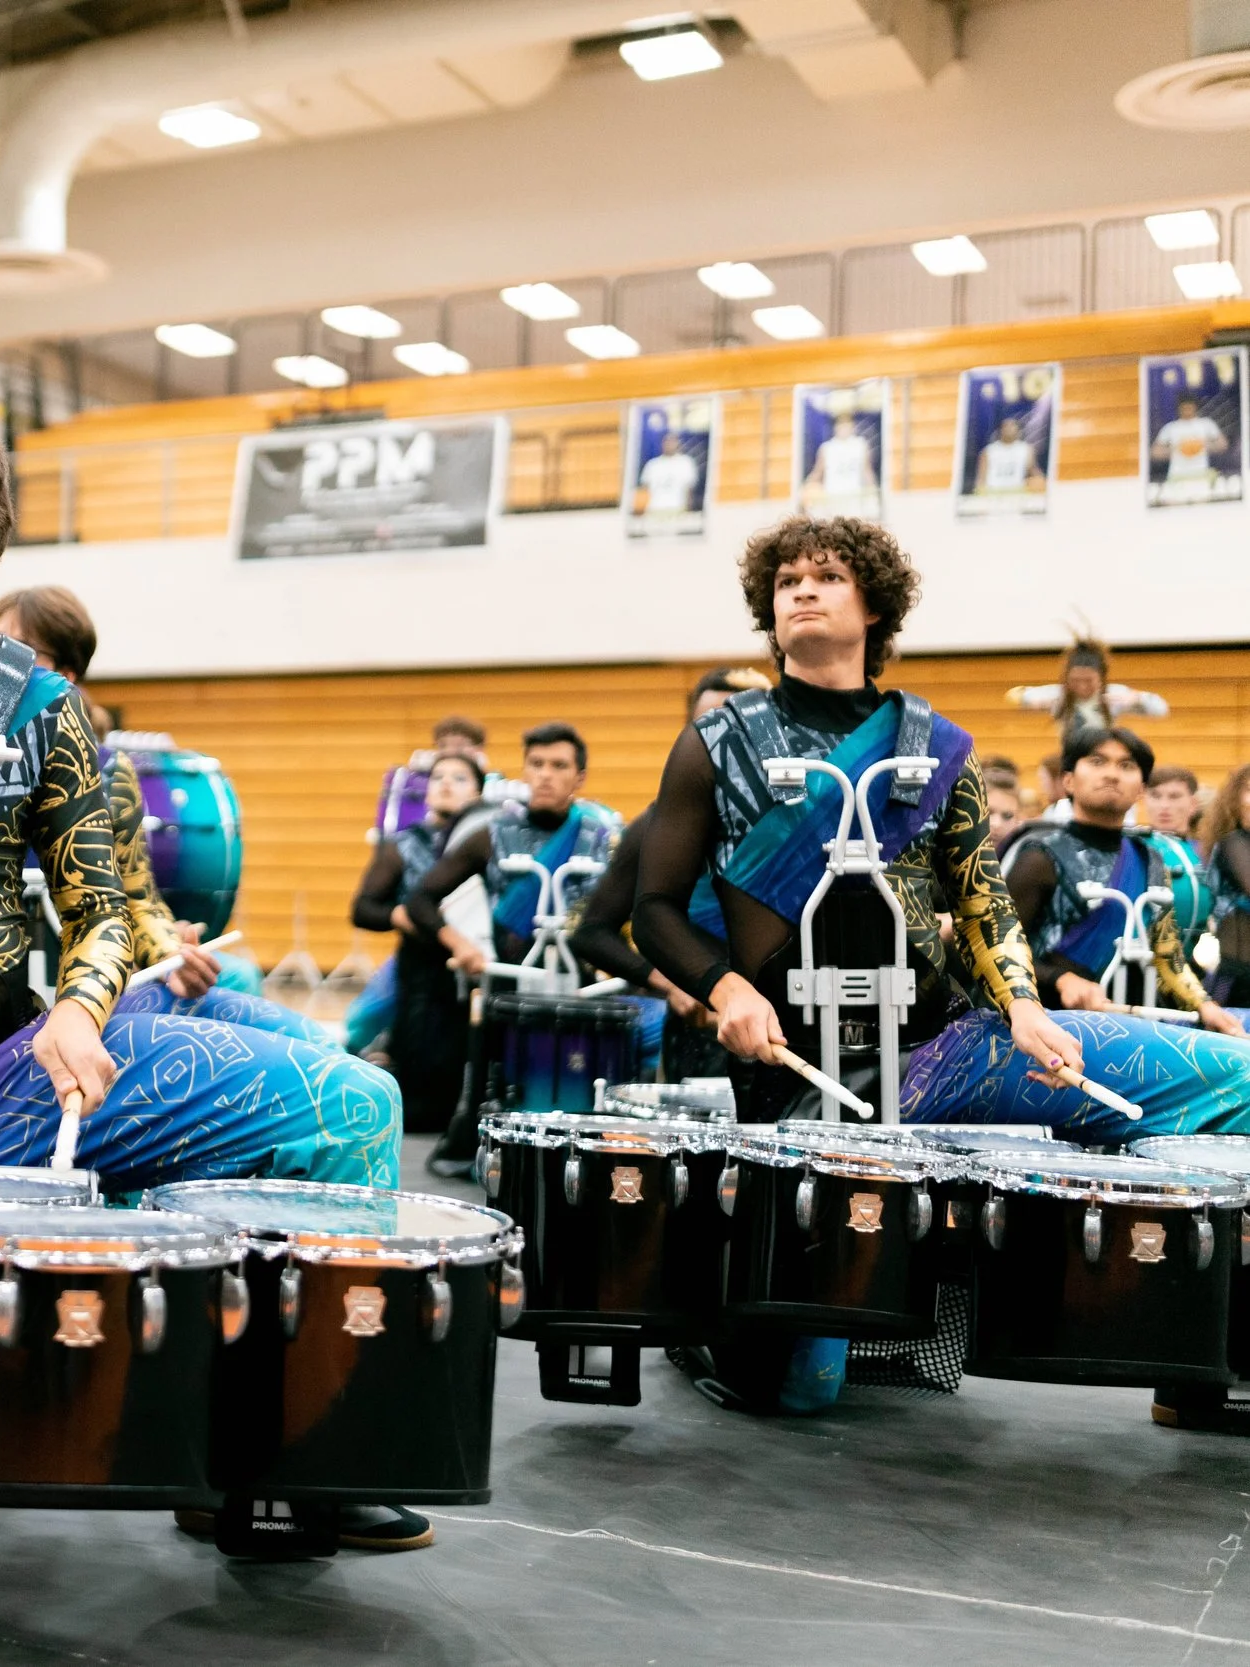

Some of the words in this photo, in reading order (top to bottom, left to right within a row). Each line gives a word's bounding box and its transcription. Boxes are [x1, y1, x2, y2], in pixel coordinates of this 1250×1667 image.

[303, 431, 436, 491] PPM
[569, 1377, 611, 1386] PROMARK
[252, 1521, 299, 1531] PROMA
